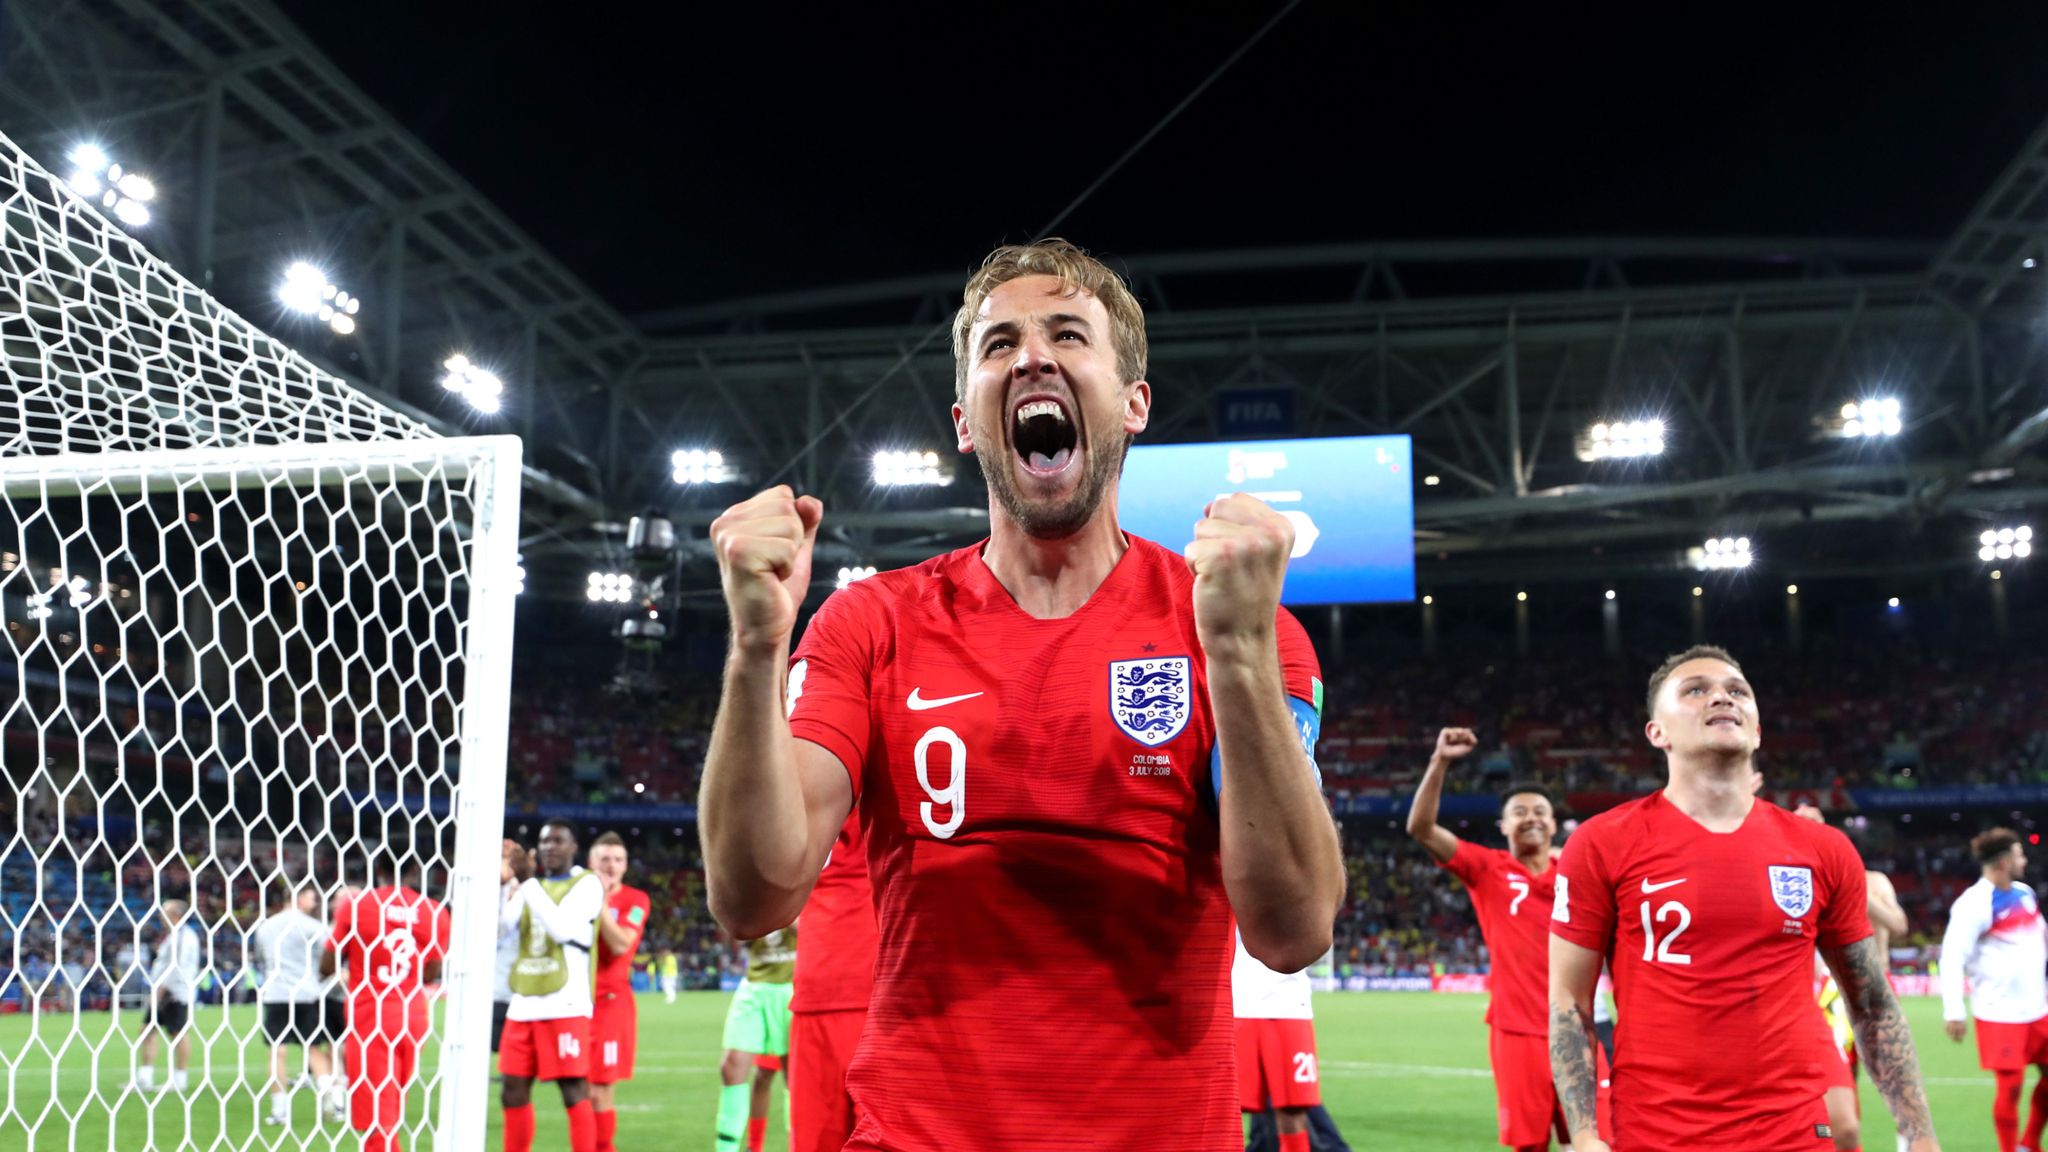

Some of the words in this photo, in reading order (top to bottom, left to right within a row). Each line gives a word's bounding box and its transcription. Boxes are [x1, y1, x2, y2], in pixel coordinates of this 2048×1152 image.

[1227, 402, 1282, 422] FIFA
[1129, 766, 1135, 776] 3
[1136, 766, 1152, 776] JULY
[1153, 767, 1171, 776] 2018
[1133, 755, 1170, 765] COLOMBIA
[914, 726, 967, 839] 9
[1509, 881, 1530, 916] 7
[1640, 900, 1691, 965] 12
[377, 927, 416, 985] 3
[558, 1032, 580, 1059] 14
[603, 1040, 618, 1066] 11
[1293, 1052, 1318, 1083] 20
